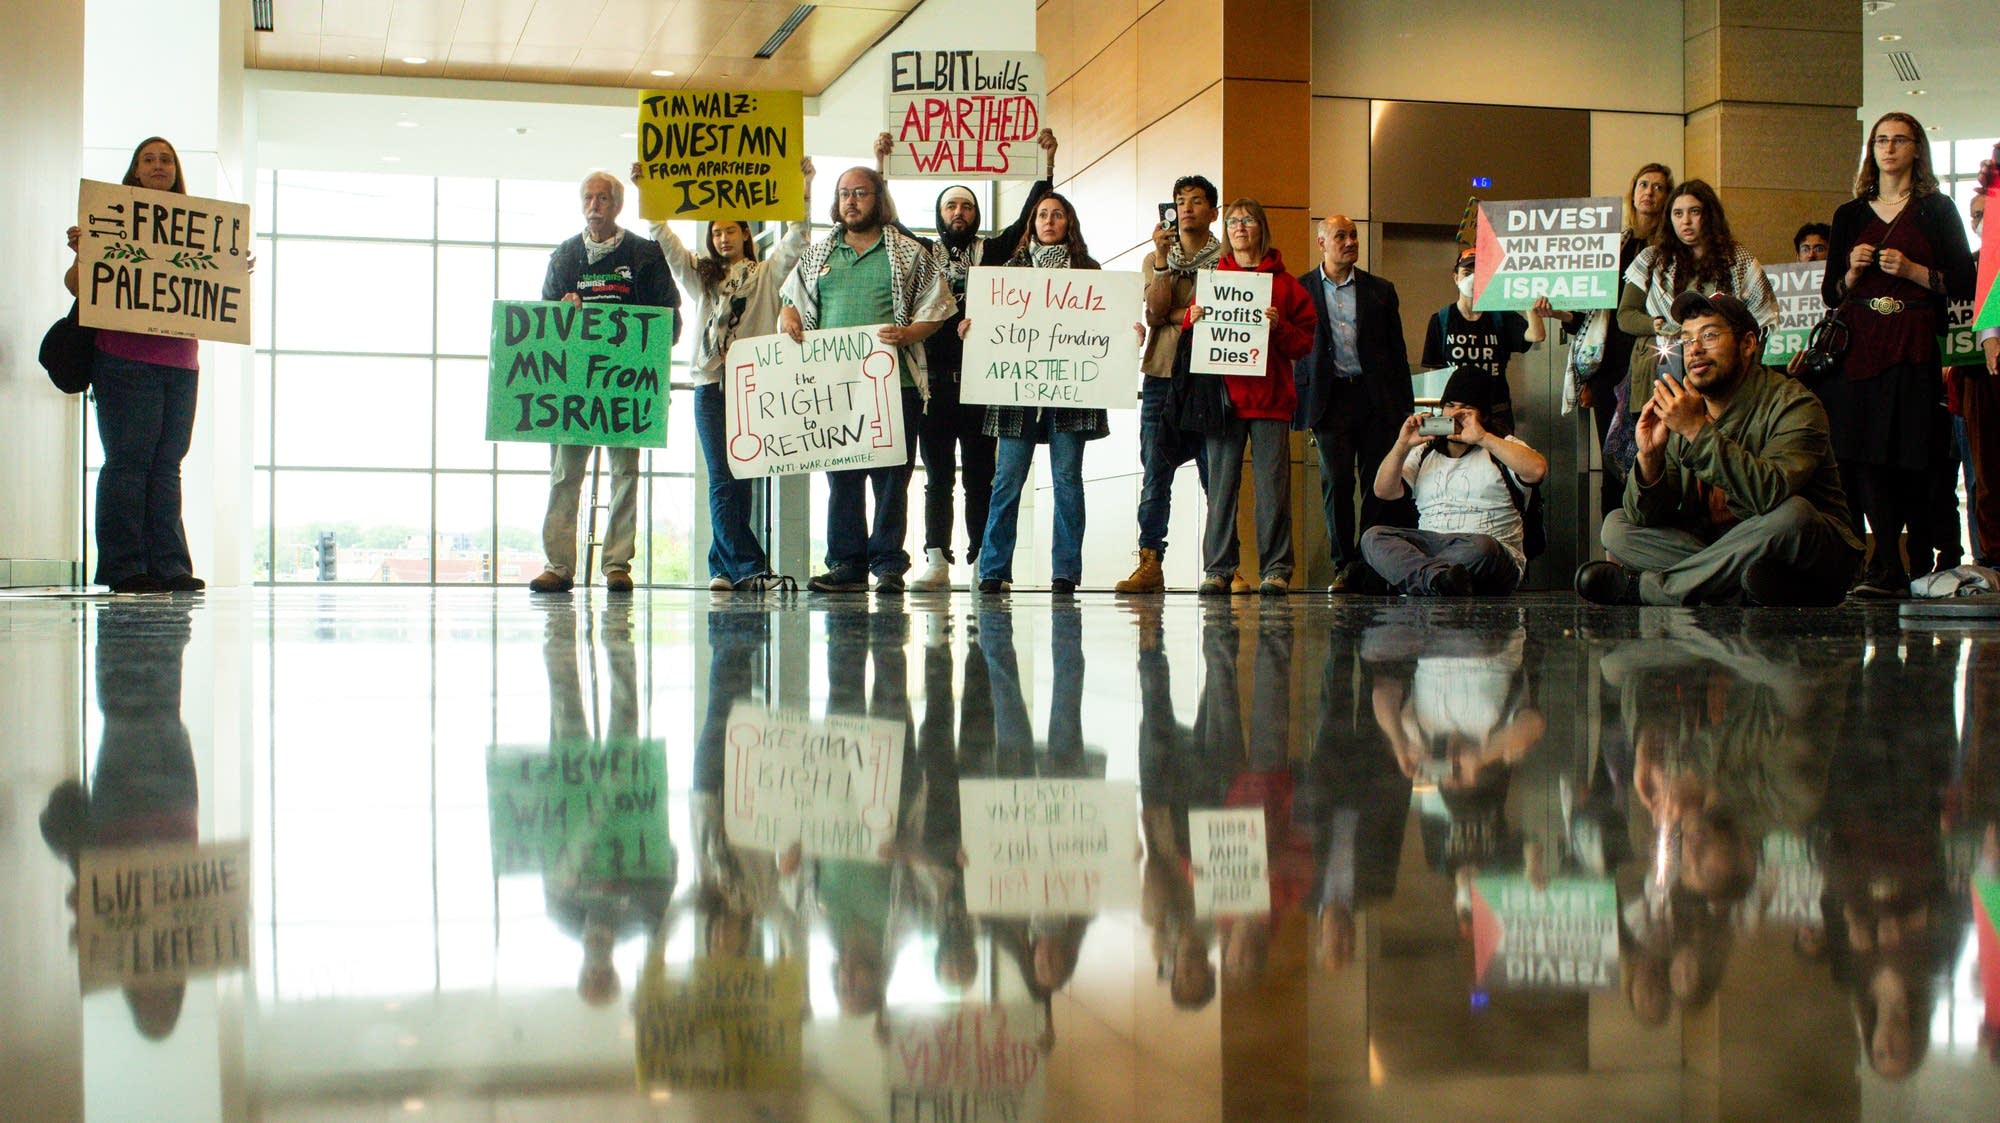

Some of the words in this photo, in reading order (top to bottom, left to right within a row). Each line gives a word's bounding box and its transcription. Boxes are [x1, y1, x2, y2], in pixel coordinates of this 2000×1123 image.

[892, 51, 973, 92] ELBIT
[975, 57, 1028, 91] builds
[693, 93, 757, 118] WALZ:
[900, 96, 1038, 142] APARTHEID
[642, 122, 734, 162] DIVEST
[738, 124, 786, 158] MN
[909, 140, 1011, 173] WALLS
[649, 162, 692, 179] FROM
[696, 161, 770, 177] APARTHEID
[673, 179, 779, 214] ISRAEL!
[132, 201, 208, 250] FREE
[1508, 206, 1613, 231] DIVEST
[1506, 238, 1538, 253] MN
[1546, 236, 1604, 252] FROM
[1503, 253, 1615, 271] APARTHEID
[91, 262, 240, 323] PALESTINE
[991, 278, 1031, 319] Hey
[1046, 278, 1106, 310] Walz
[1214, 286, 1254, 302] Who
[1504, 275, 1607, 299] ISRAEL
[1202, 306, 1262, 325] Profit$
[505, 305, 661, 352] DIVE$T
[1048, 323, 1110, 359] funding
[1211, 327, 1250, 342] Who
[1447, 334, 1477, 345] NOT
[755, 341, 783, 367] WE
[800, 332, 873, 363] DEMAND
[1209, 348, 1259, 364] Dies?
[1452, 346, 1494, 360] OUR
[506, 350, 567, 388] MN
[796, 373, 816, 386] the
[986, 359, 1099, 382] APARTHEID
[759, 380, 862, 419] RIGHT
[1015, 382, 1083, 402] ISRAEL
[515, 393, 652, 434] ISRAEL!
[804, 416, 817, 431] to
[763, 414, 865, 456] RETURN
[824, 452, 875, 467] COMMITTEE
